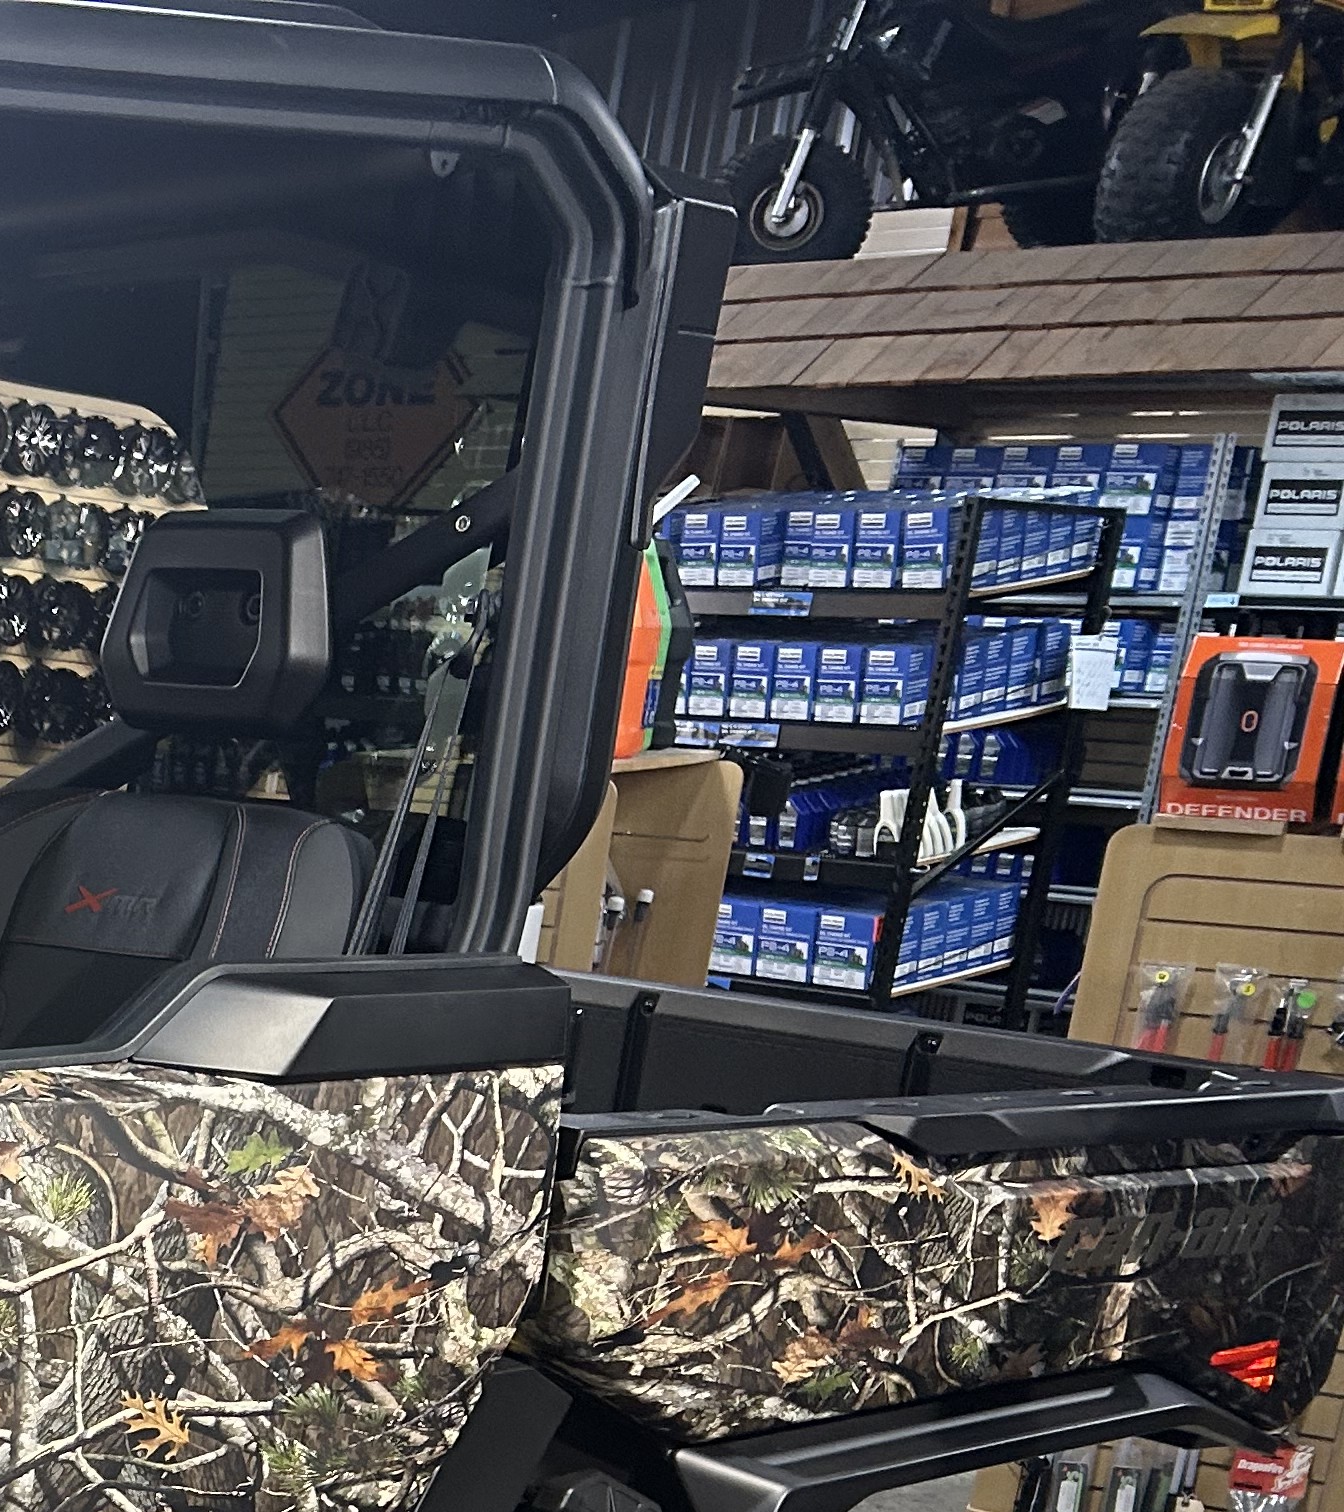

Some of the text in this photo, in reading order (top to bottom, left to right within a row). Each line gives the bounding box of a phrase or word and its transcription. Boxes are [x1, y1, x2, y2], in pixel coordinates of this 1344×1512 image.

[1277, 420, 1344, 432] POLARIS
[1269, 489, 1338, 501] POLARIS
[1254, 556, 1323, 568] POLARIS
[1166, 802, 1308, 823] DEFENDER
